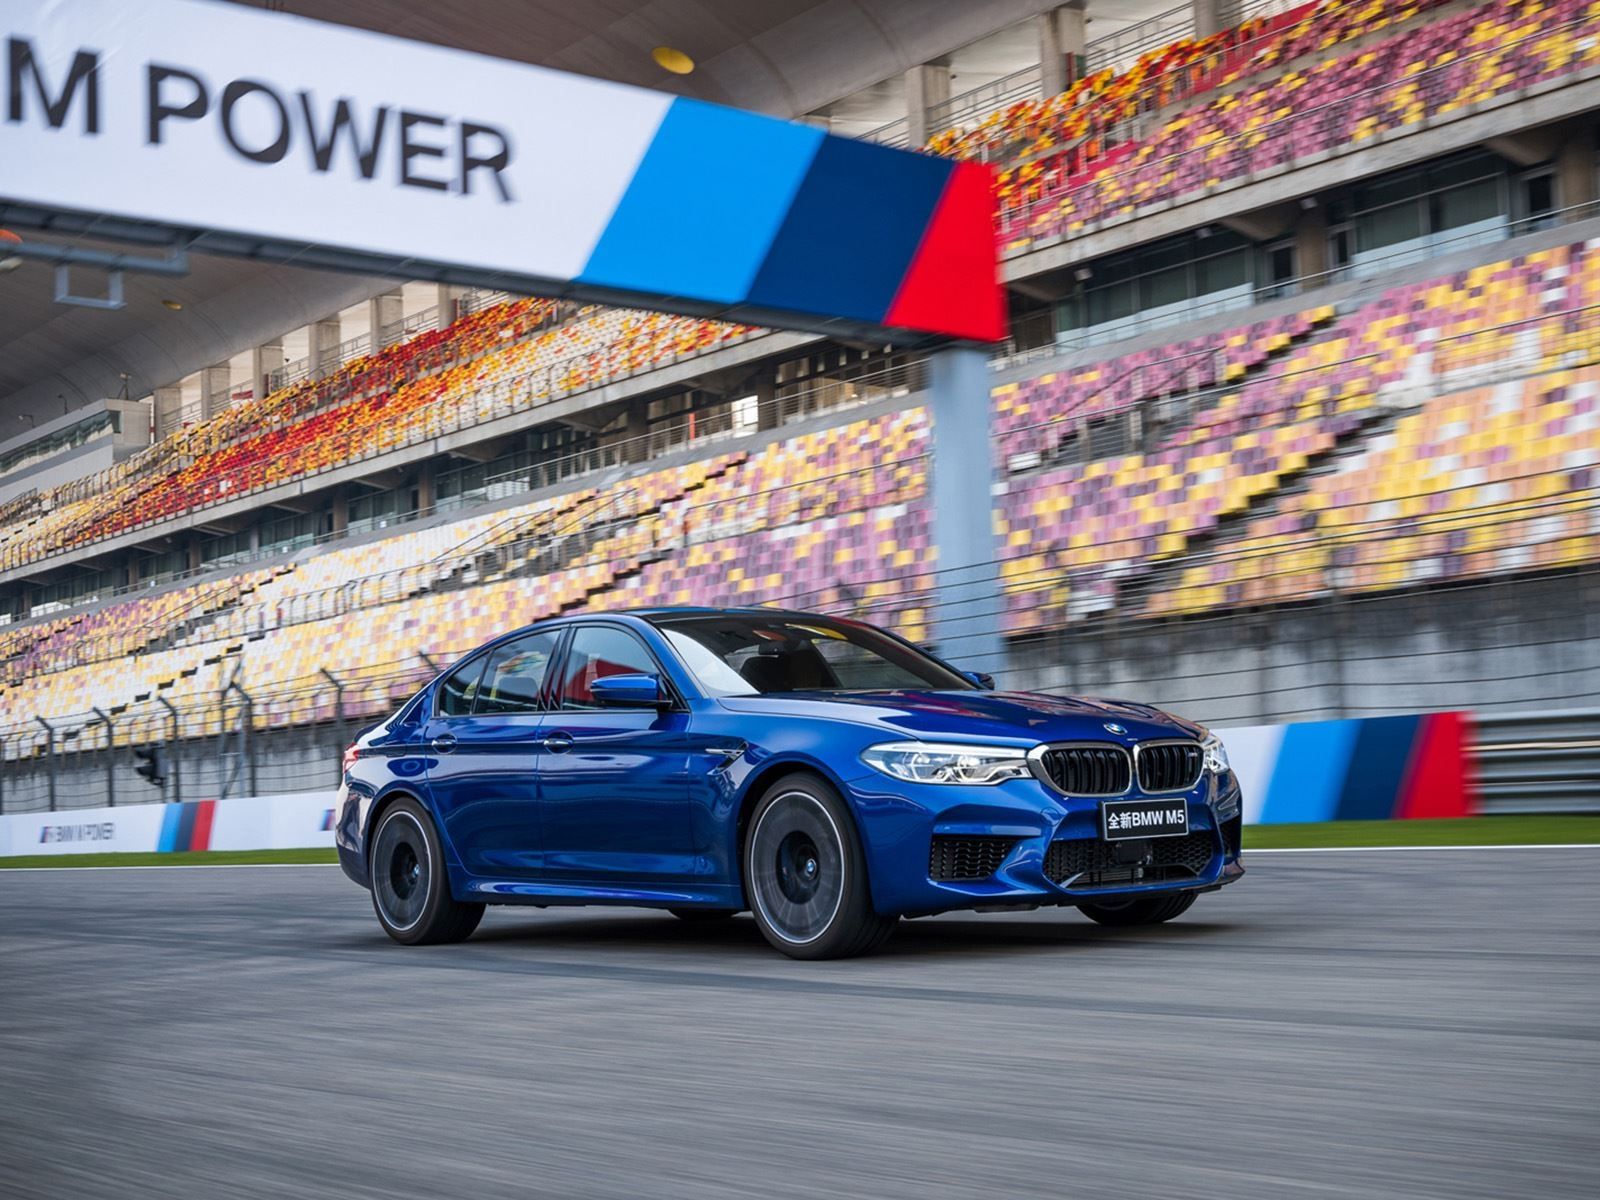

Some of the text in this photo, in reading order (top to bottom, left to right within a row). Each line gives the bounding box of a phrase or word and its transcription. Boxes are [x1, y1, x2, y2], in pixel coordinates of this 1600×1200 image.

[7, 36, 517, 203] M POWER
[1166, 810, 1185, 825] M5
